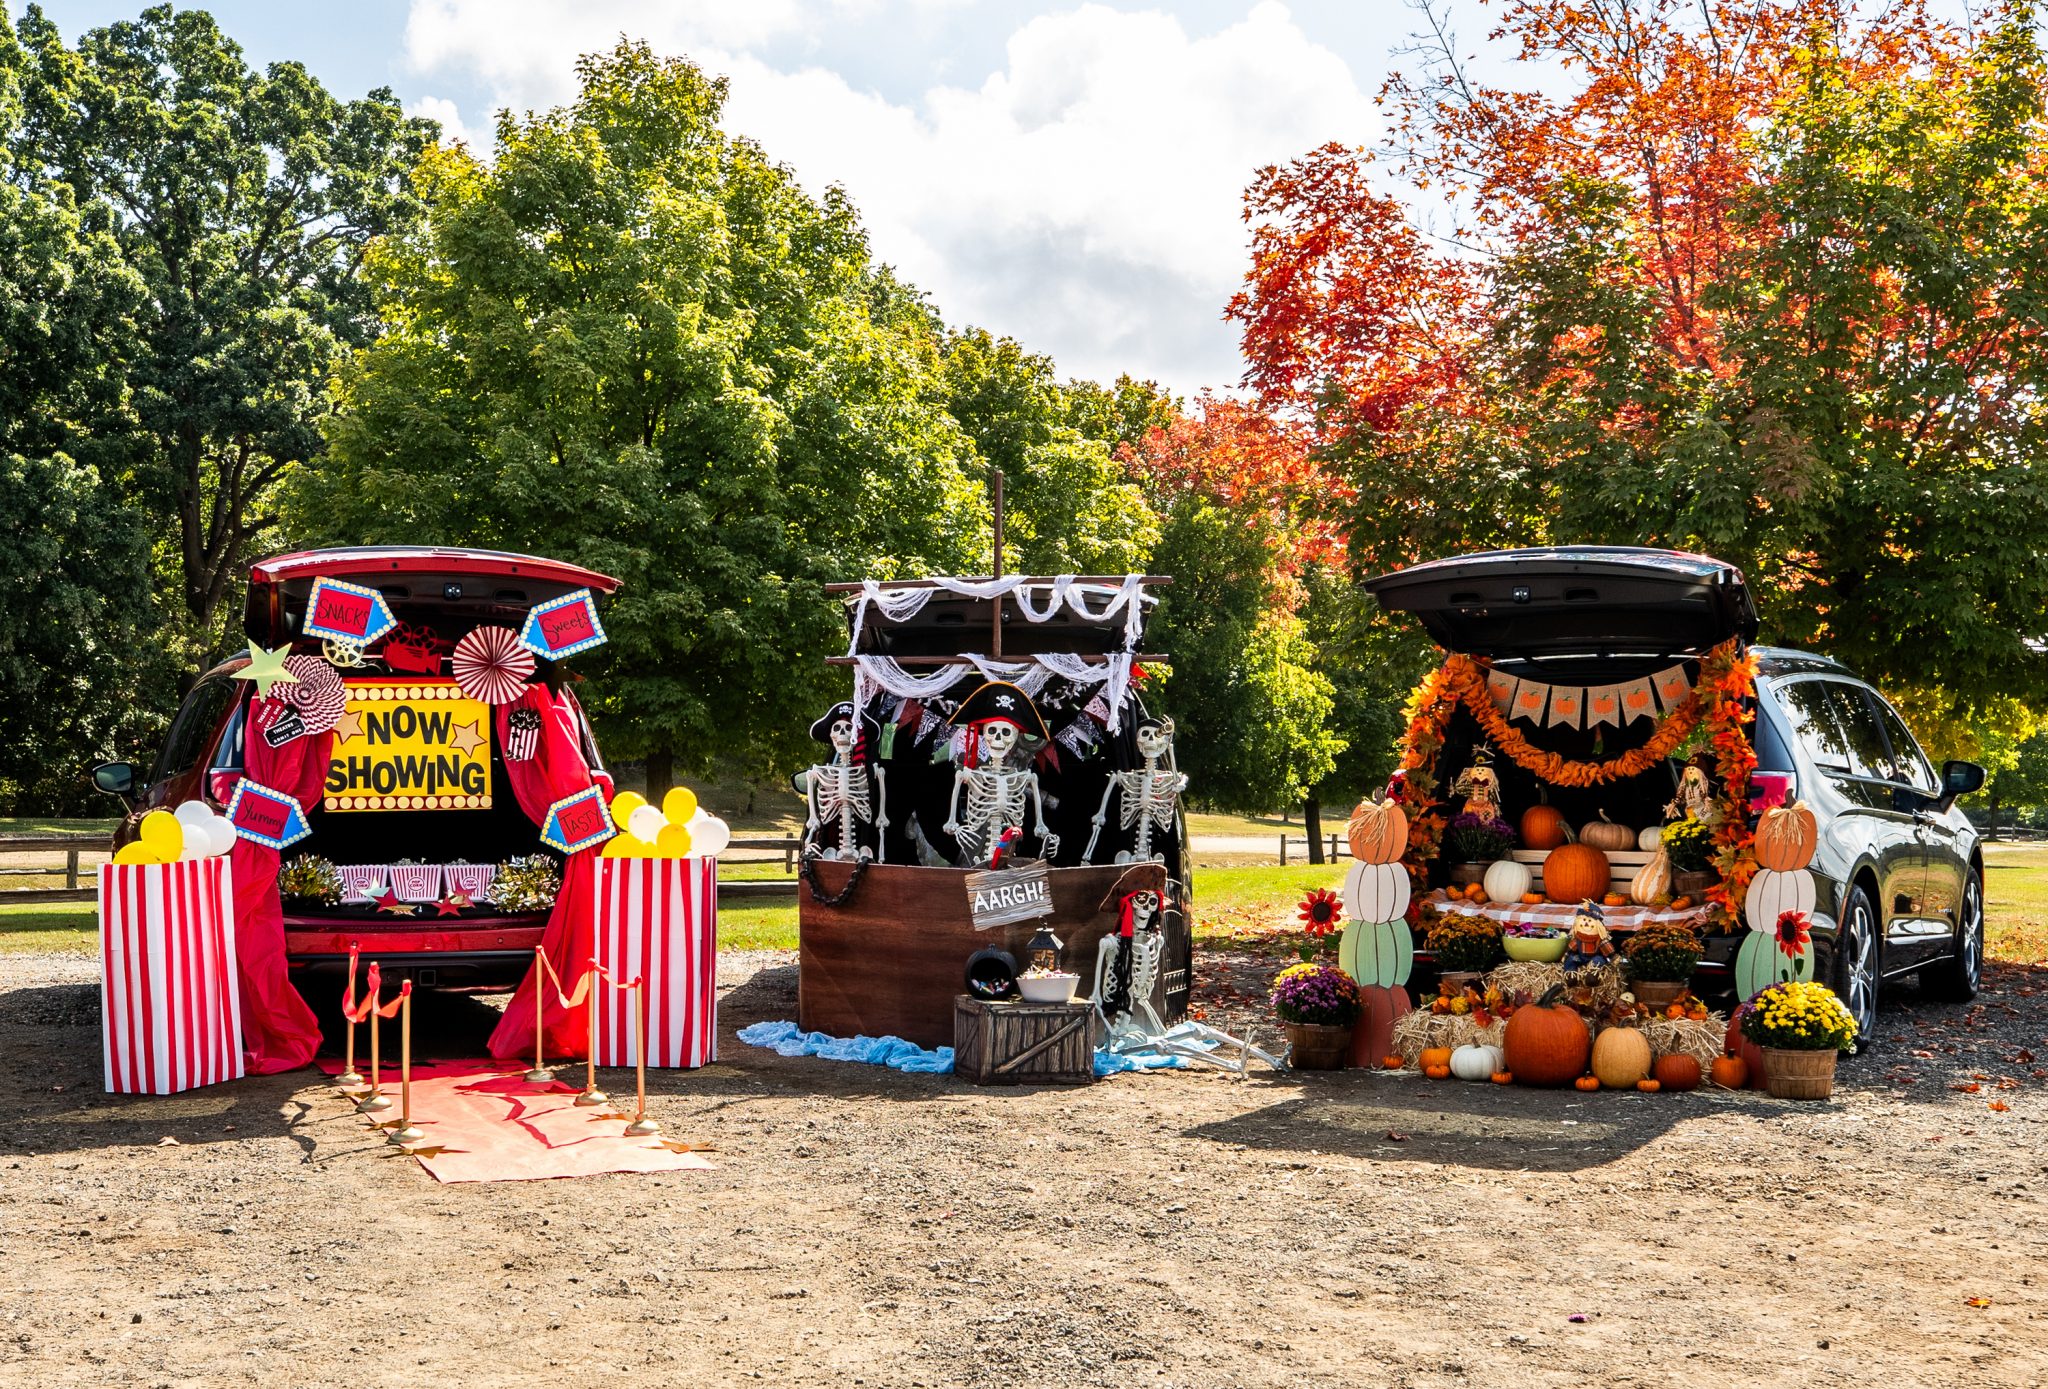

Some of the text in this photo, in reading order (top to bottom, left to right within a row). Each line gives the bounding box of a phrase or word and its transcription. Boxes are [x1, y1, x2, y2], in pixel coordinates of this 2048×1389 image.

[318, 598, 370, 630] SNACKS
[541, 610, 590, 645] Sweets
[257, 704, 272, 723] THEATRE
[273, 705, 281, 715] ONE
[366, 705, 452, 746] NOW
[272, 721, 294, 734] THEATRE
[273, 733, 290, 743] ADMIT
[325, 754, 485, 795] SHOWING
[240, 798, 285, 834] Yummy
[560, 808, 601, 836] TASTY
[973, 881, 1045, 914] AARGH!
